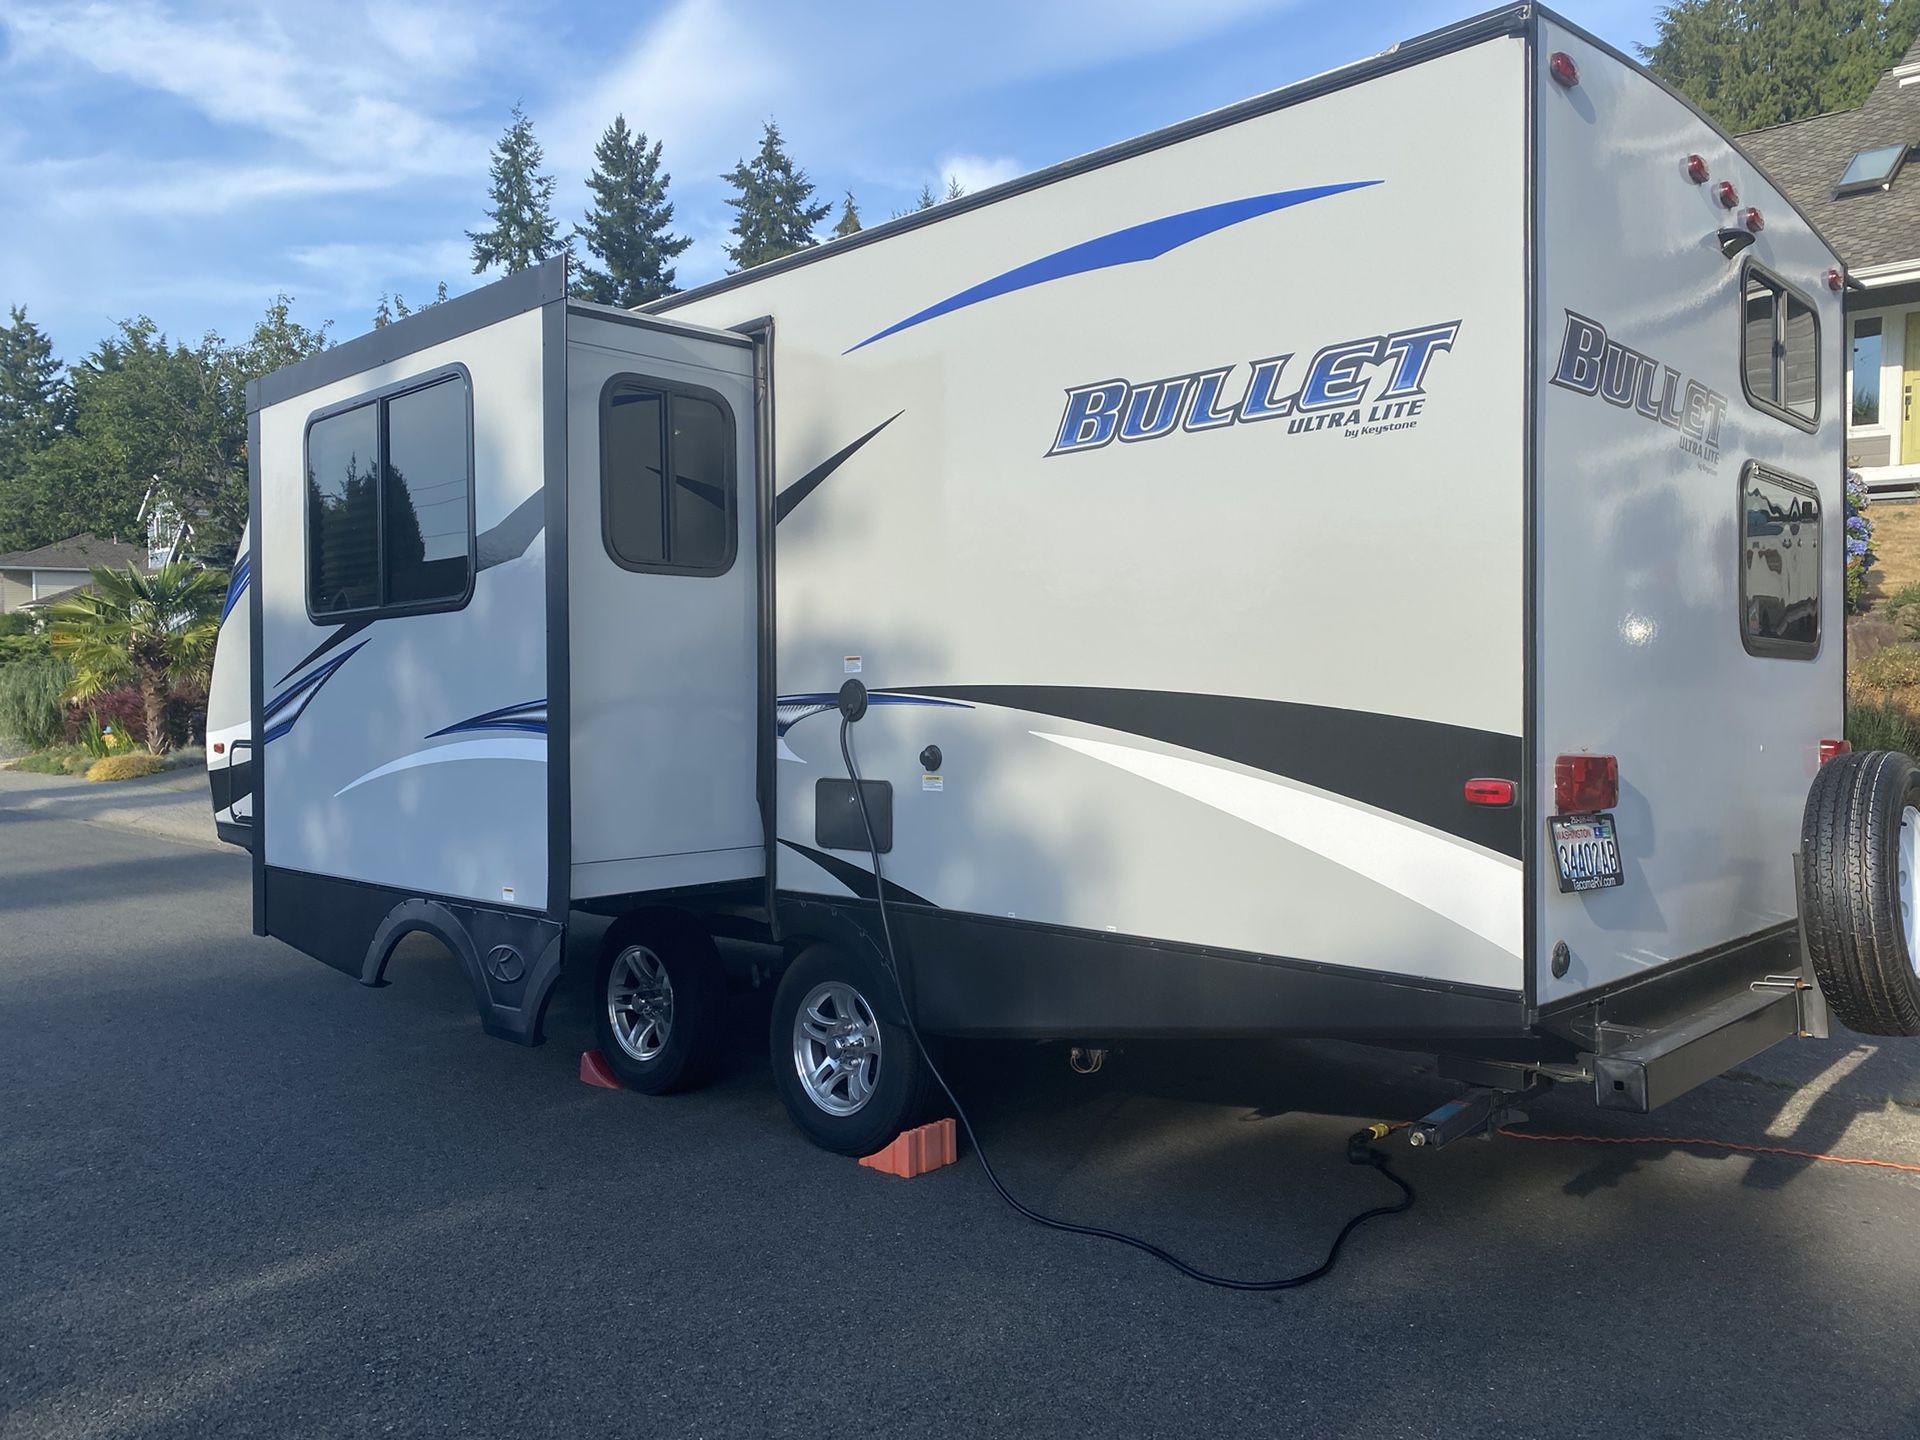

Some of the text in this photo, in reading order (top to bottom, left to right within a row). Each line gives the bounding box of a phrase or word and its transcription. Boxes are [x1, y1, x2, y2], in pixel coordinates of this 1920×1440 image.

[1042, 319, 1463, 458] BULLET
[1548, 308, 1728, 449] BULLET
[1287, 399, 1426, 434] ULTRA LITE
[1344, 421, 1417, 438] by Keystone
[1679, 436, 1719, 464] ULTRA LITE
[1556, 829, 1591, 840] WASHINGTON
[1572, 877, 1616, 890] TacomaRV.com
